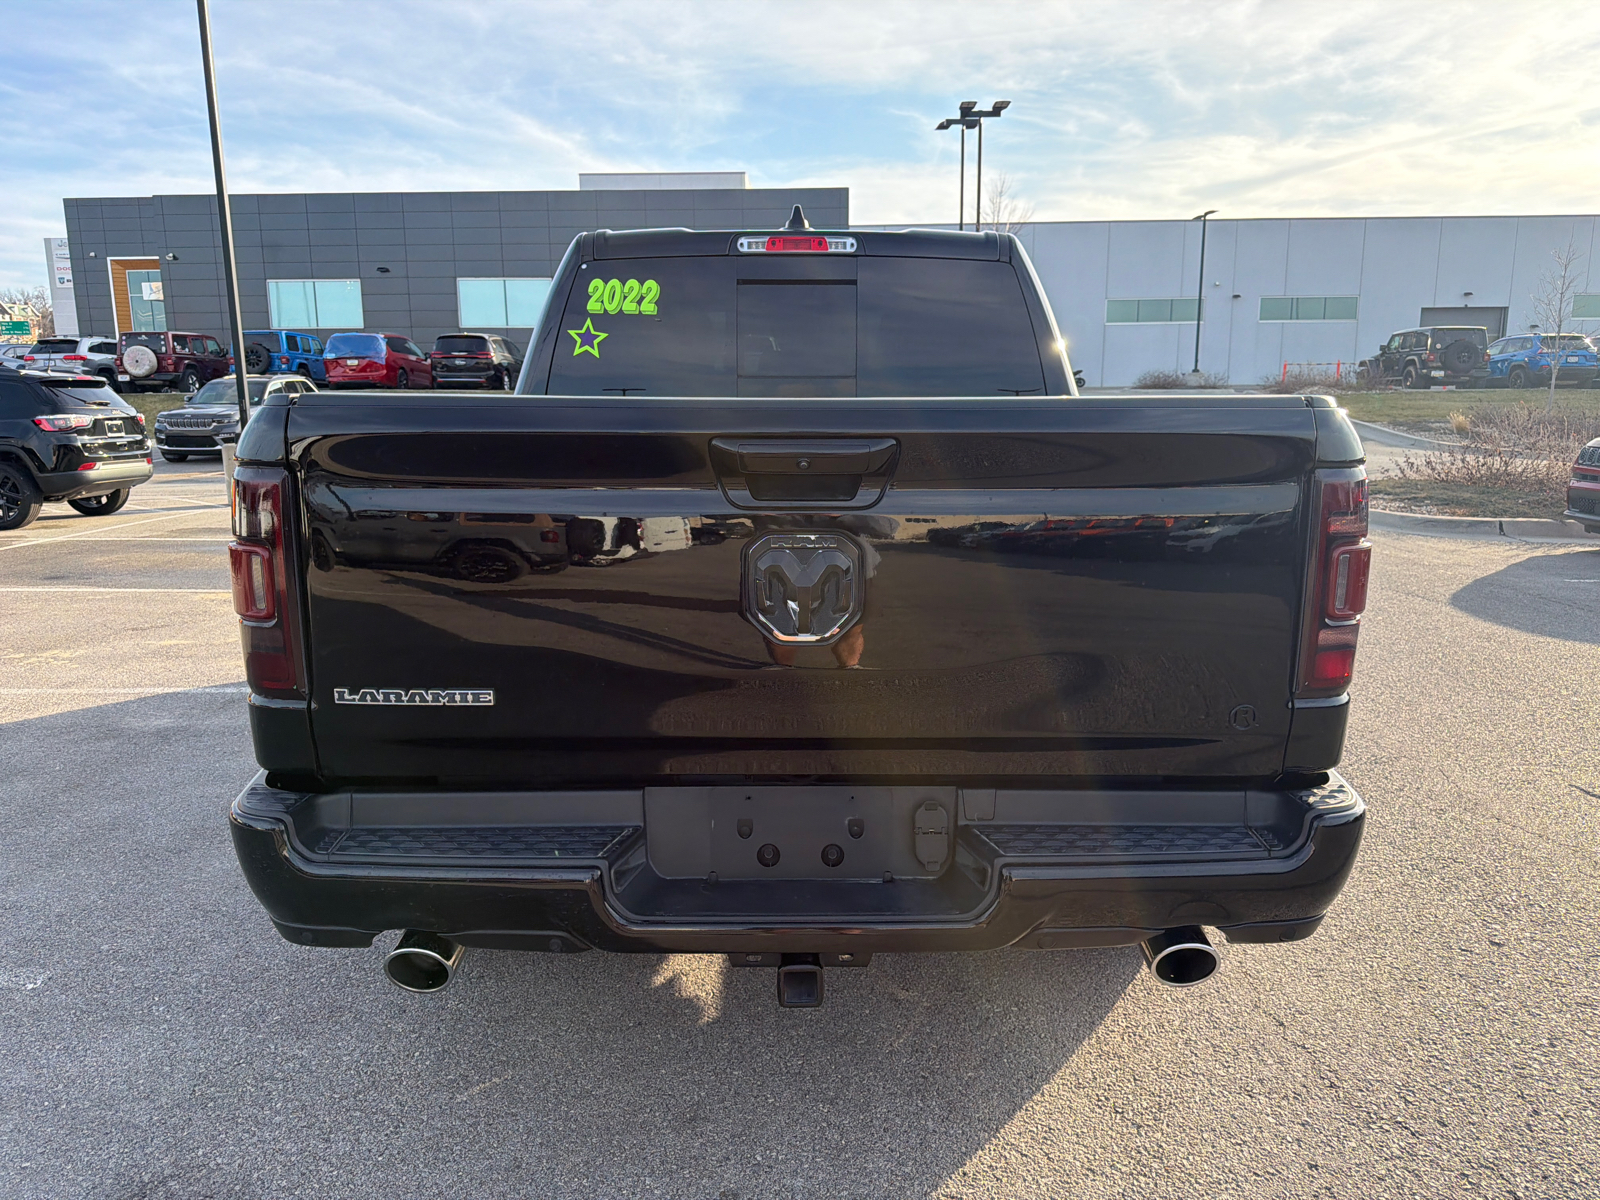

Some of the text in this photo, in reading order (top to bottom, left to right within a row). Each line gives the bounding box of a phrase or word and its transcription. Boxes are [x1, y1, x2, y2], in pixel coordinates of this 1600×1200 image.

[587, 278, 660, 315] 2022
[770, 537, 838, 548] RAM
[333, 688, 495, 706] LARAMIE
